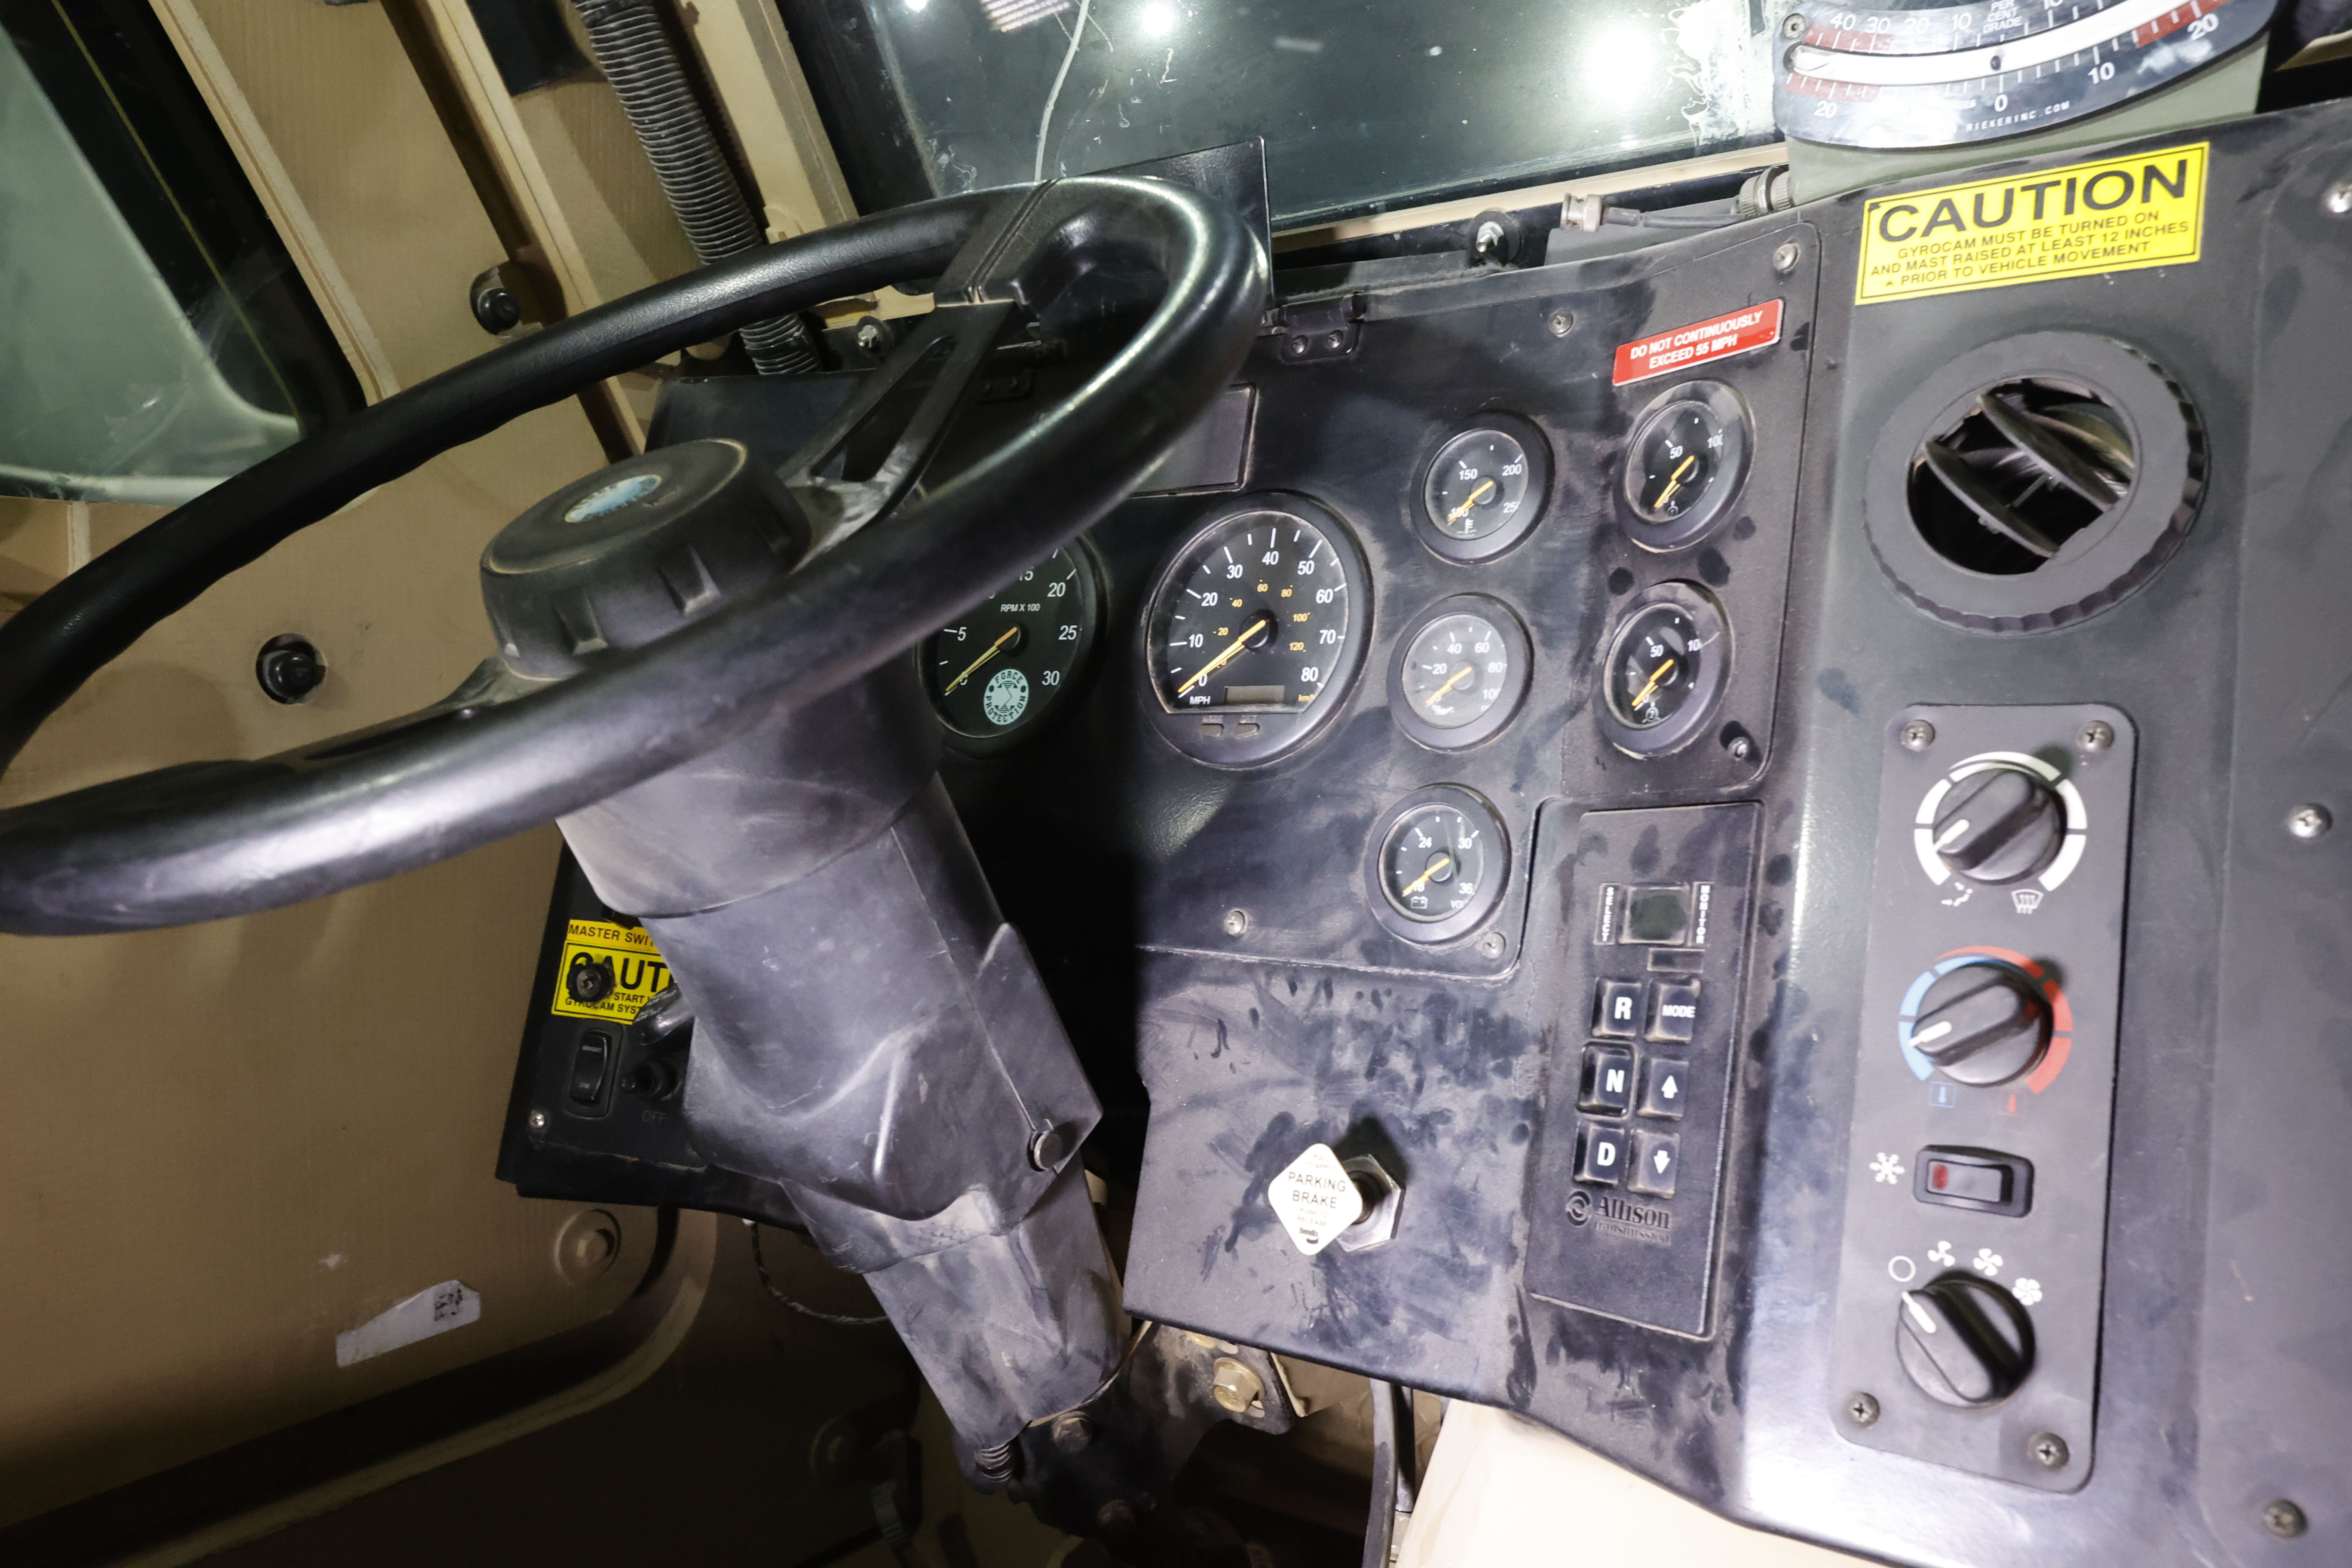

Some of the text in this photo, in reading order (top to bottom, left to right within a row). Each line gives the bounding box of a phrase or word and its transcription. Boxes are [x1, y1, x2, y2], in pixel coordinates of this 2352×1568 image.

[1987, 6, 2018, 23] CENT
[1830, 12, 1972, 34] 40 30 20 10
[1982, 16, 2023, 34] GRADE
[2187, 13, 2219, 40] 20
[2088, 62, 2115, 84] 10
[1814, 101, 1838, 118] 20
[1994, 95, 2008, 112] 0
[1879, 159, 2188, 242] CAUTION
[1898, 211, 2159, 258] GYROCAM MUST BE TURNED ON
[1870, 221, 2190, 277] AND MAST RAISED AT LEAST 12 INCHES
[1901, 241, 2151, 286] PRIOR TO VEHICLE MOVEMENT
[1630, 311, 1763, 359] DO NOT CONTINUOUSLY
[1649, 334, 1738, 369] EXCEED 55 MPH
[1669, 445, 1684, 459] 50
[1459, 464, 1522, 481] 150 200
[1262, 551, 1279, 565] 40
[1226, 564, 1243, 579] 30
[1297, 560, 1314, 575] 50
[1047, 582, 1066, 597] 20
[1257, 583, 1268, 592] 60
[1281, 588, 1292, 597] 80
[1201, 592, 1218, 606] 20
[1231, 599, 1242, 607] 40
[1316, 588, 1333, 603] 60
[1000, 603, 1041, 612] RPM X 100
[1292, 613, 1308, 622] 100
[957, 627, 967, 641] 5
[1059, 625, 1077, 640] 25
[1218, 627, 1228, 636] 20
[1319, 630, 1336, 644] 70
[1188, 634, 1203, 648] 10
[1289, 641, 1305, 651] 120
[1447, 643, 1462, 654] 40
[1475, 642, 1490, 653] 60
[1650, 639, 1703, 658] 50 10
[1301, 667, 1318, 682] 80
[1432, 663, 1447, 674] 20
[1488, 662, 1503, 673] 80
[995, 671, 1024, 684] FORCE
[1042, 671, 1060, 686] 30
[1199, 673, 1207, 687] 0
[1189, 695, 1211, 705] MPH
[986, 695, 1026, 722] PROTECTION
[1419, 837, 1432, 848] 24
[1458, 838, 1472, 849] 30
[1459, 882, 1473, 894] 36
[1602, 887, 1614, 942] SELECT
[1696, 885, 1711, 944] MONITOR
[569, 924, 653, 946] MASTER SWI
[614, 992, 645, 1004] START
[1614, 997, 1632, 1020] R
[1662, 1004, 1696, 1018] MODE
[1606, 1069, 1625, 1093] N
[642, 1110, 667, 1123] OFF
[1597, 1142, 1616, 1166] D
[1288, 1172, 1346, 1192] PARKING
[1292, 1190, 1337, 1209] BRAKE
[1594, 1196, 1670, 1230] Allison
